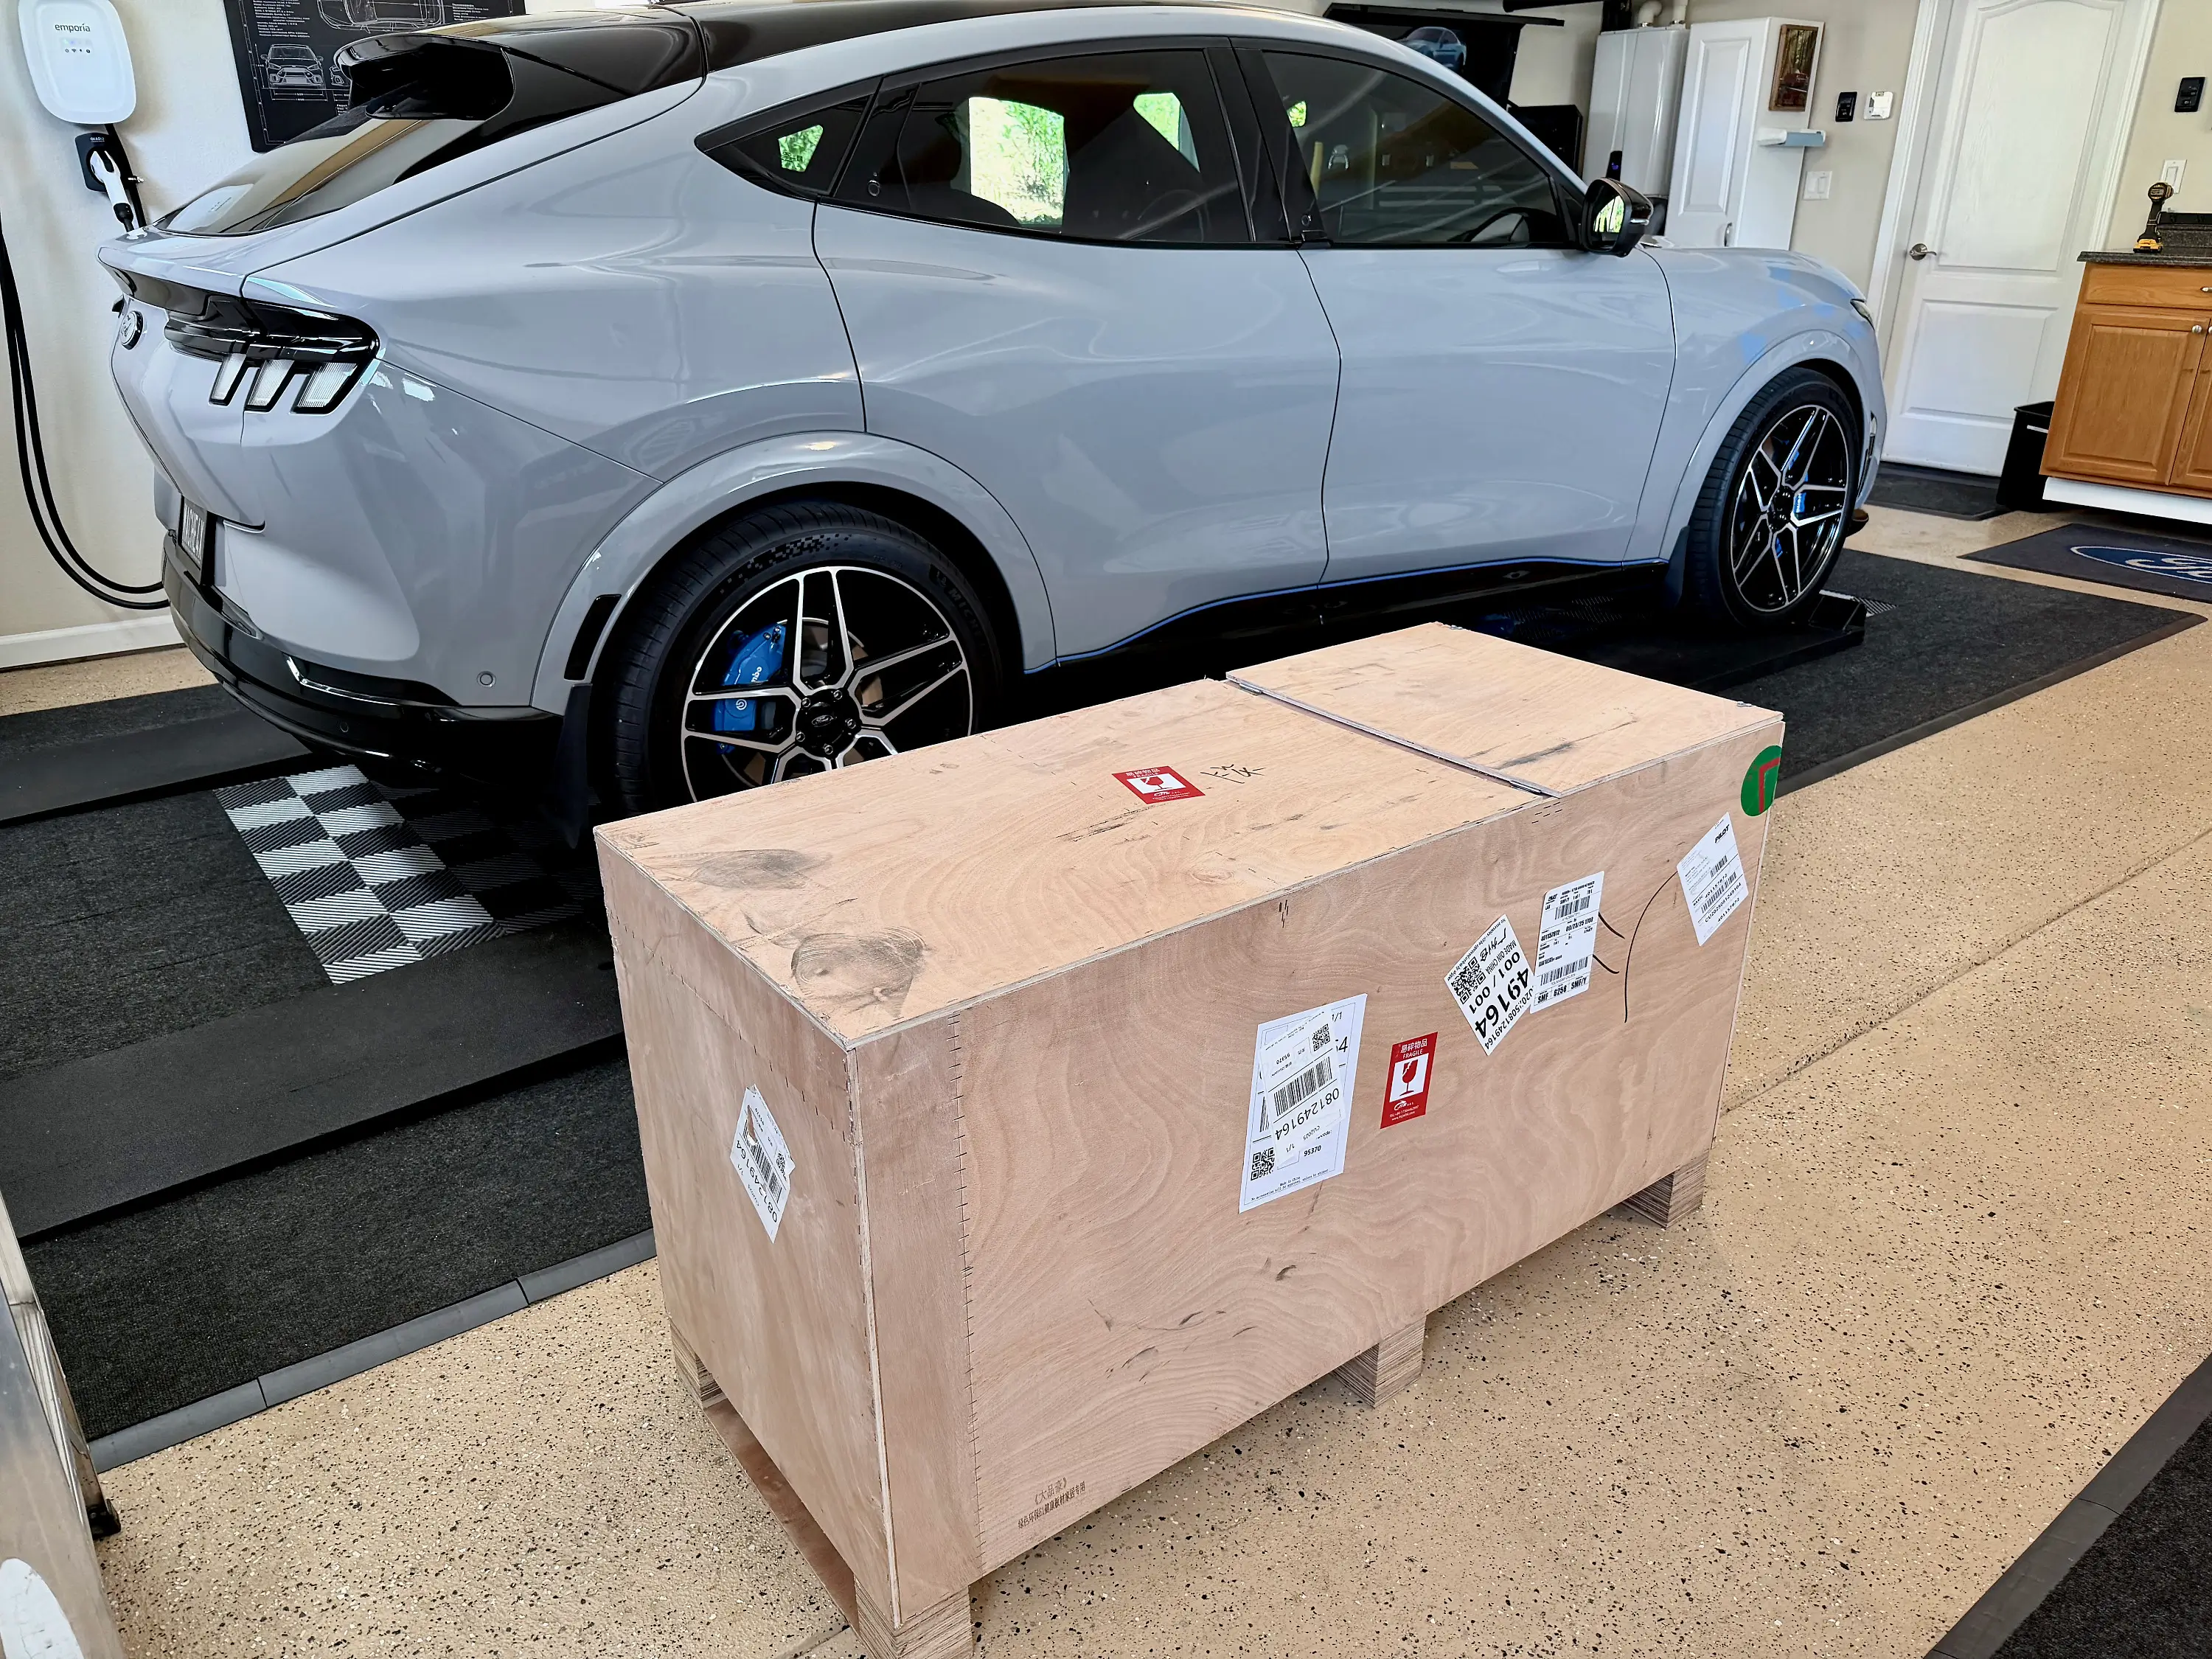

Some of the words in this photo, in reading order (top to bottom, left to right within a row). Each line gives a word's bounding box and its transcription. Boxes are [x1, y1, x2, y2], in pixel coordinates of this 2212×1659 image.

[55, 23, 91, 33] emporia
[1503, 939, 1517, 955] MADE
[1485, 959, 1498, 975] CHINA
[1475, 968, 1529, 1038] 49164
[1331, 1011, 1343, 1023] 1/1
[1402, 1048, 1423, 1059] FRAGILE
[1275, 1087, 1340, 1141] 081249164
[1303, 1144, 1322, 1157] 95370
